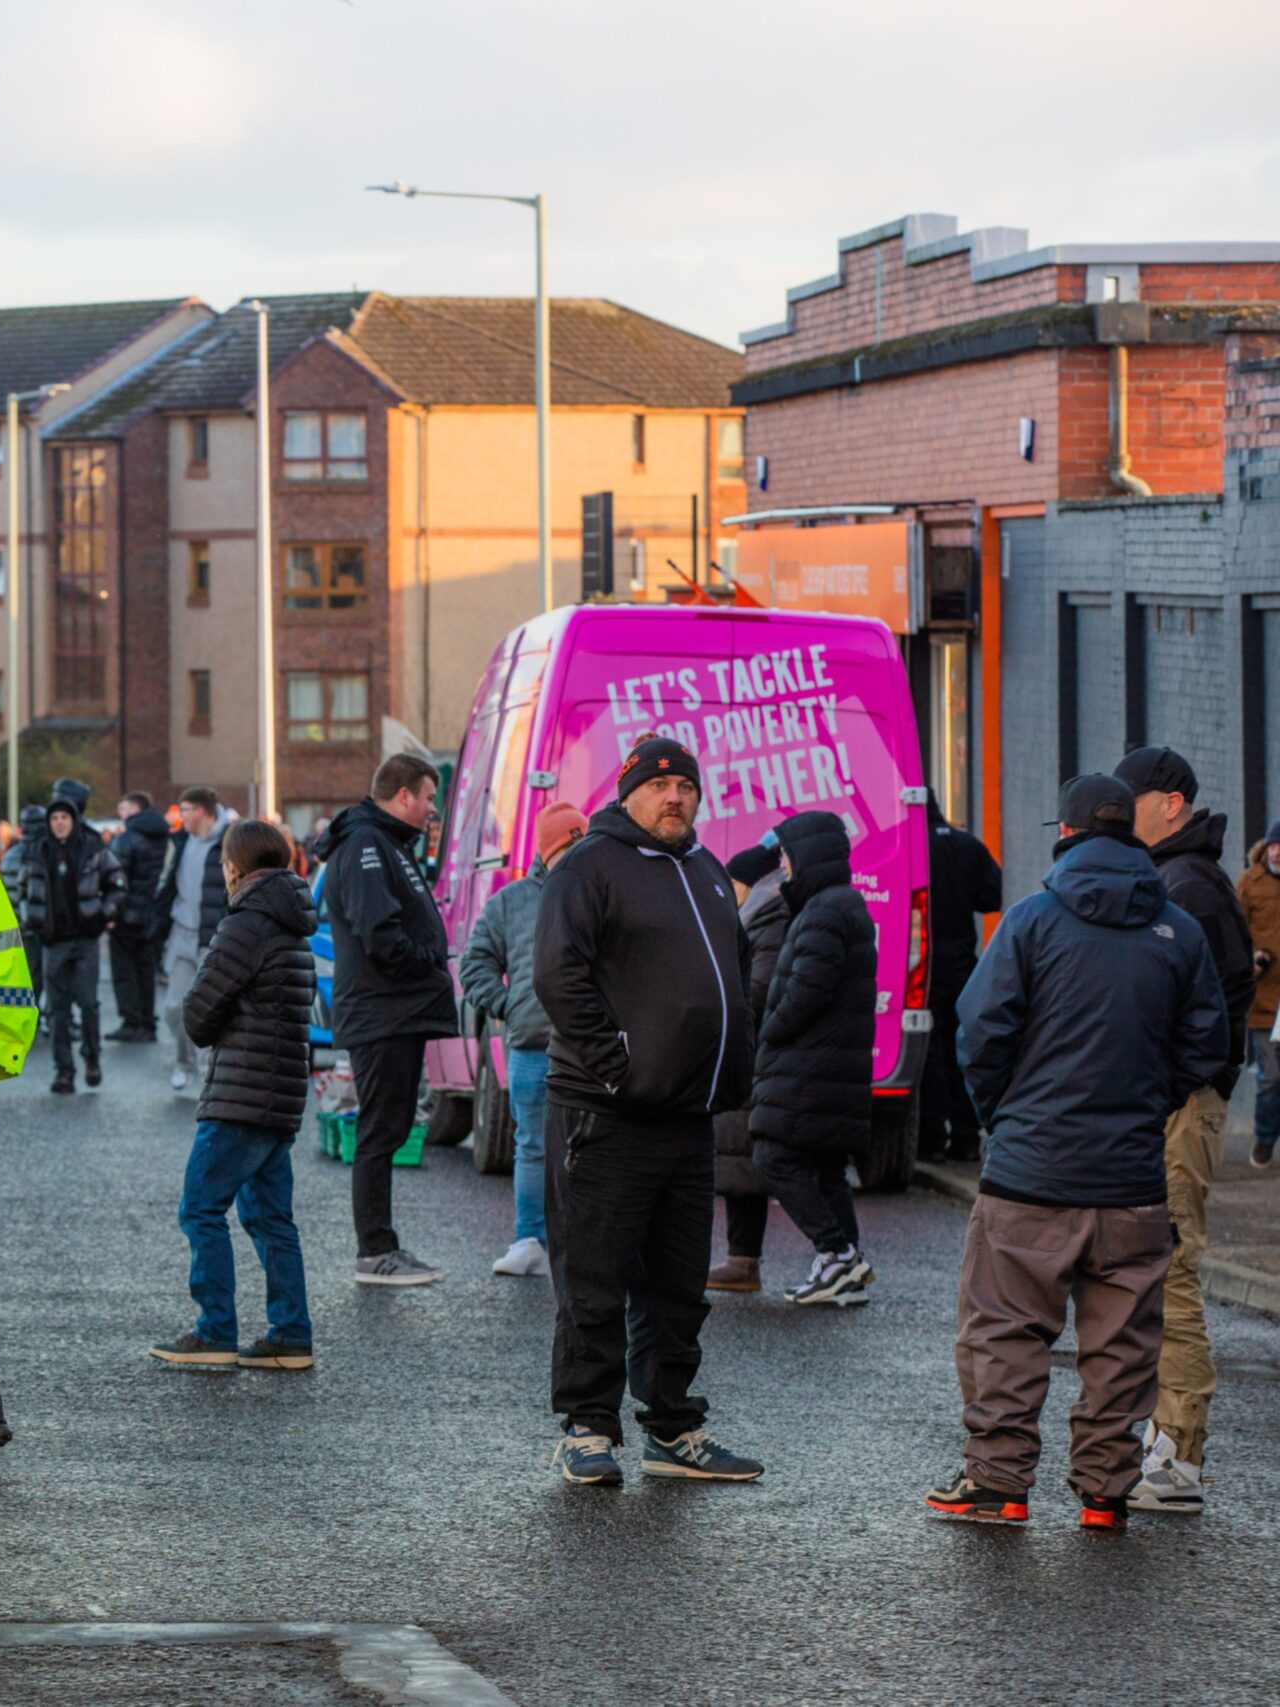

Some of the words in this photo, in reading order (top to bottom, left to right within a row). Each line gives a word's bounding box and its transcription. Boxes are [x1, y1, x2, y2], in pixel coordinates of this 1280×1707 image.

[607, 667, 702, 726] LET'S
[707, 643, 834, 705] TACKLE
[616, 720, 699, 763] FD
[703, 693, 838, 757] POVERTY
[695, 742, 855, 824] ETHER!
[851, 872, 878, 889] ting
